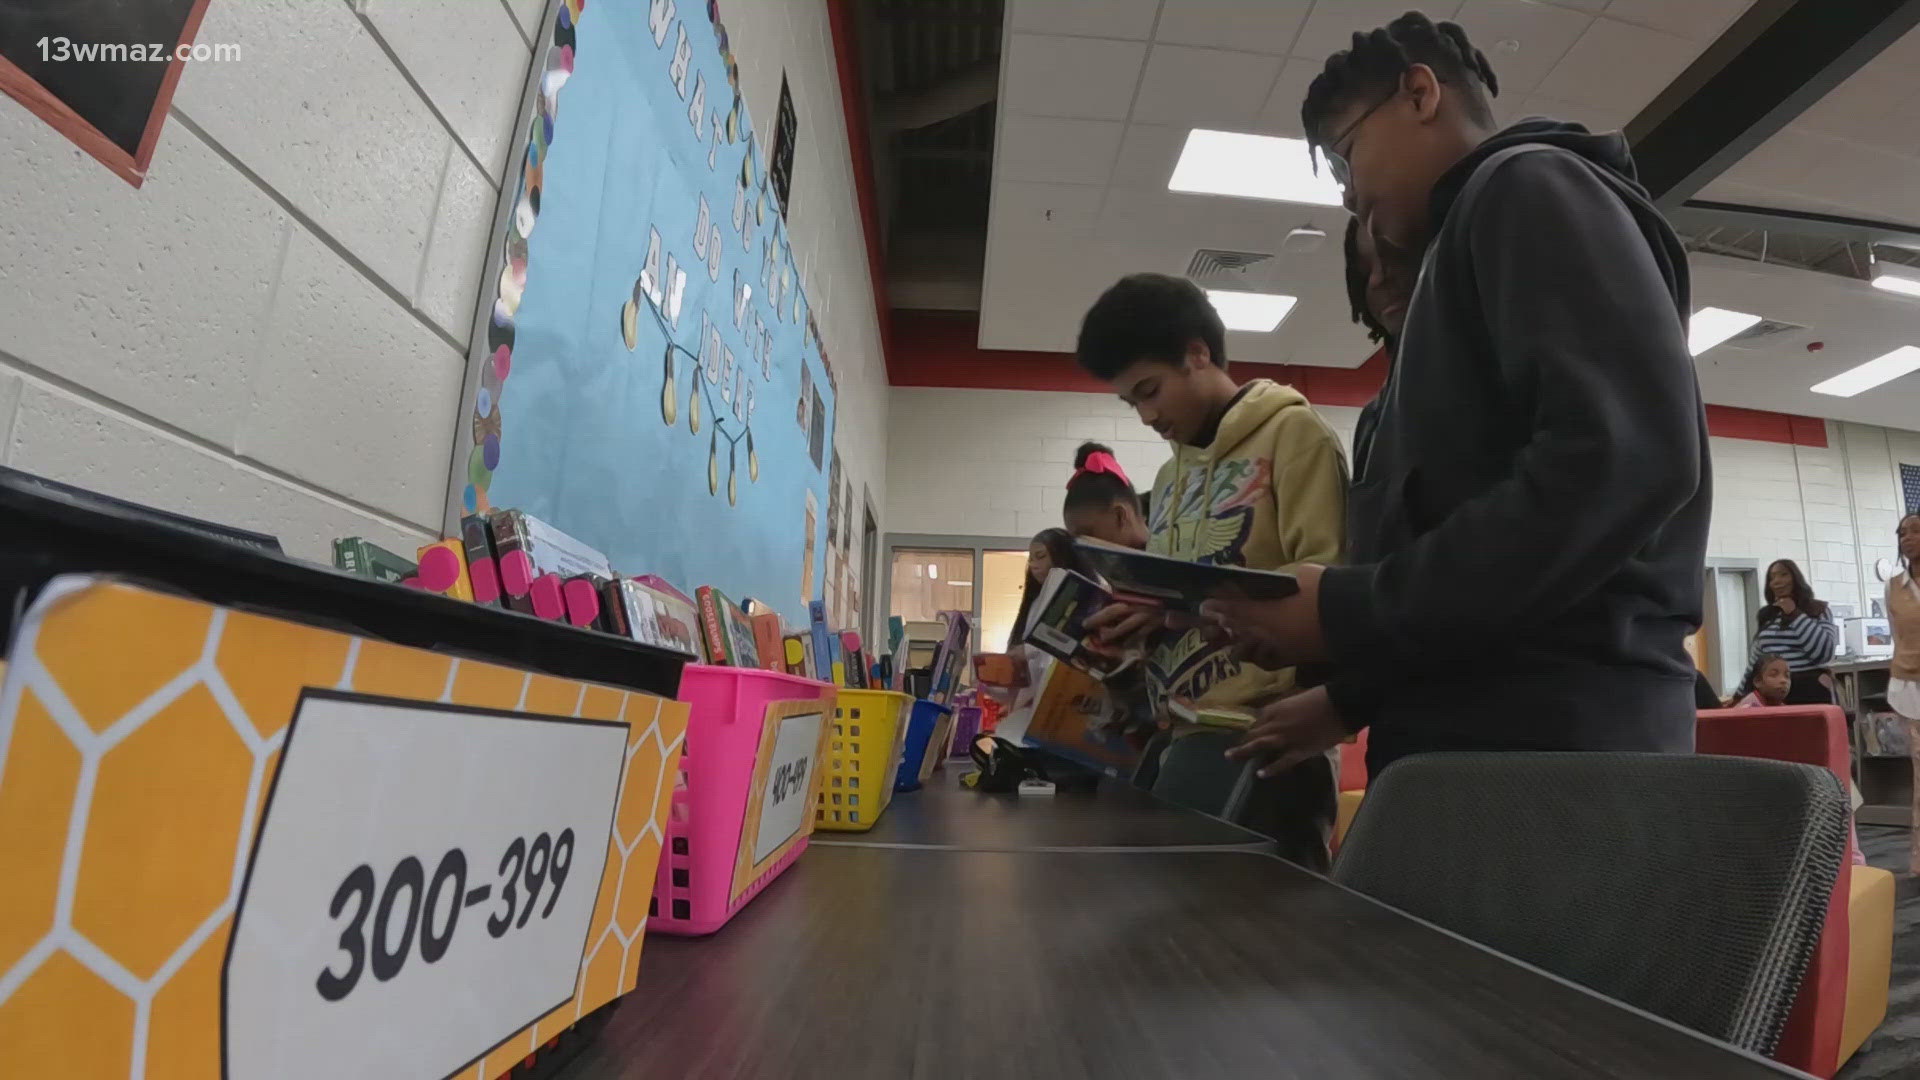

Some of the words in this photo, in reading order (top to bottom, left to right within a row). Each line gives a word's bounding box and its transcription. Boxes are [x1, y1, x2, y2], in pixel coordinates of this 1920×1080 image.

[648, 0, 723, 172] WHAT
[640, 222, 687, 332] AN
[693, 190, 722, 284] DO
[732, 267, 773, 383] WITH
[316, 827, 575, 1002] 300-399
